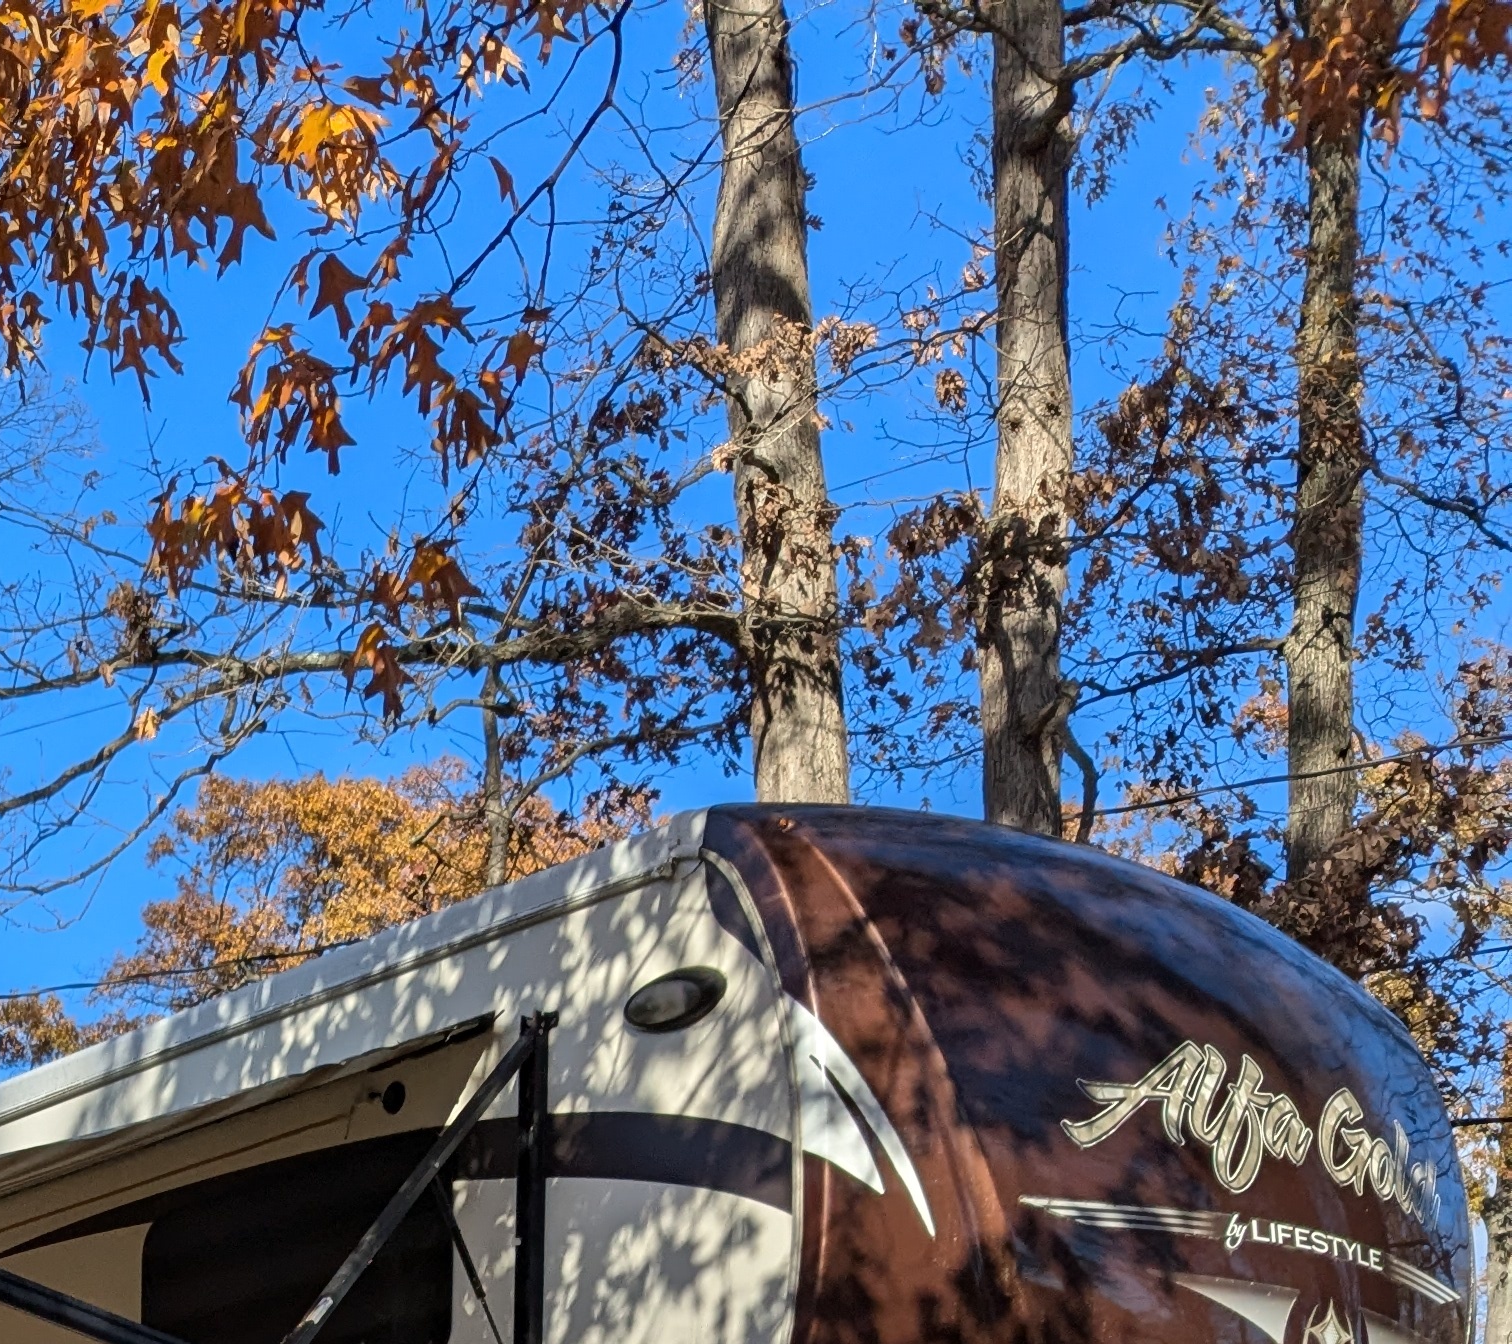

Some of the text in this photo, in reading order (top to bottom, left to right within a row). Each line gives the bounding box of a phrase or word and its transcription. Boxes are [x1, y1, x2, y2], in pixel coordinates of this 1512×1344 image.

[1060, 1040, 1441, 1230] Alfa Gold
[1226, 1213, 1384, 1272] by LIFESTYLE
